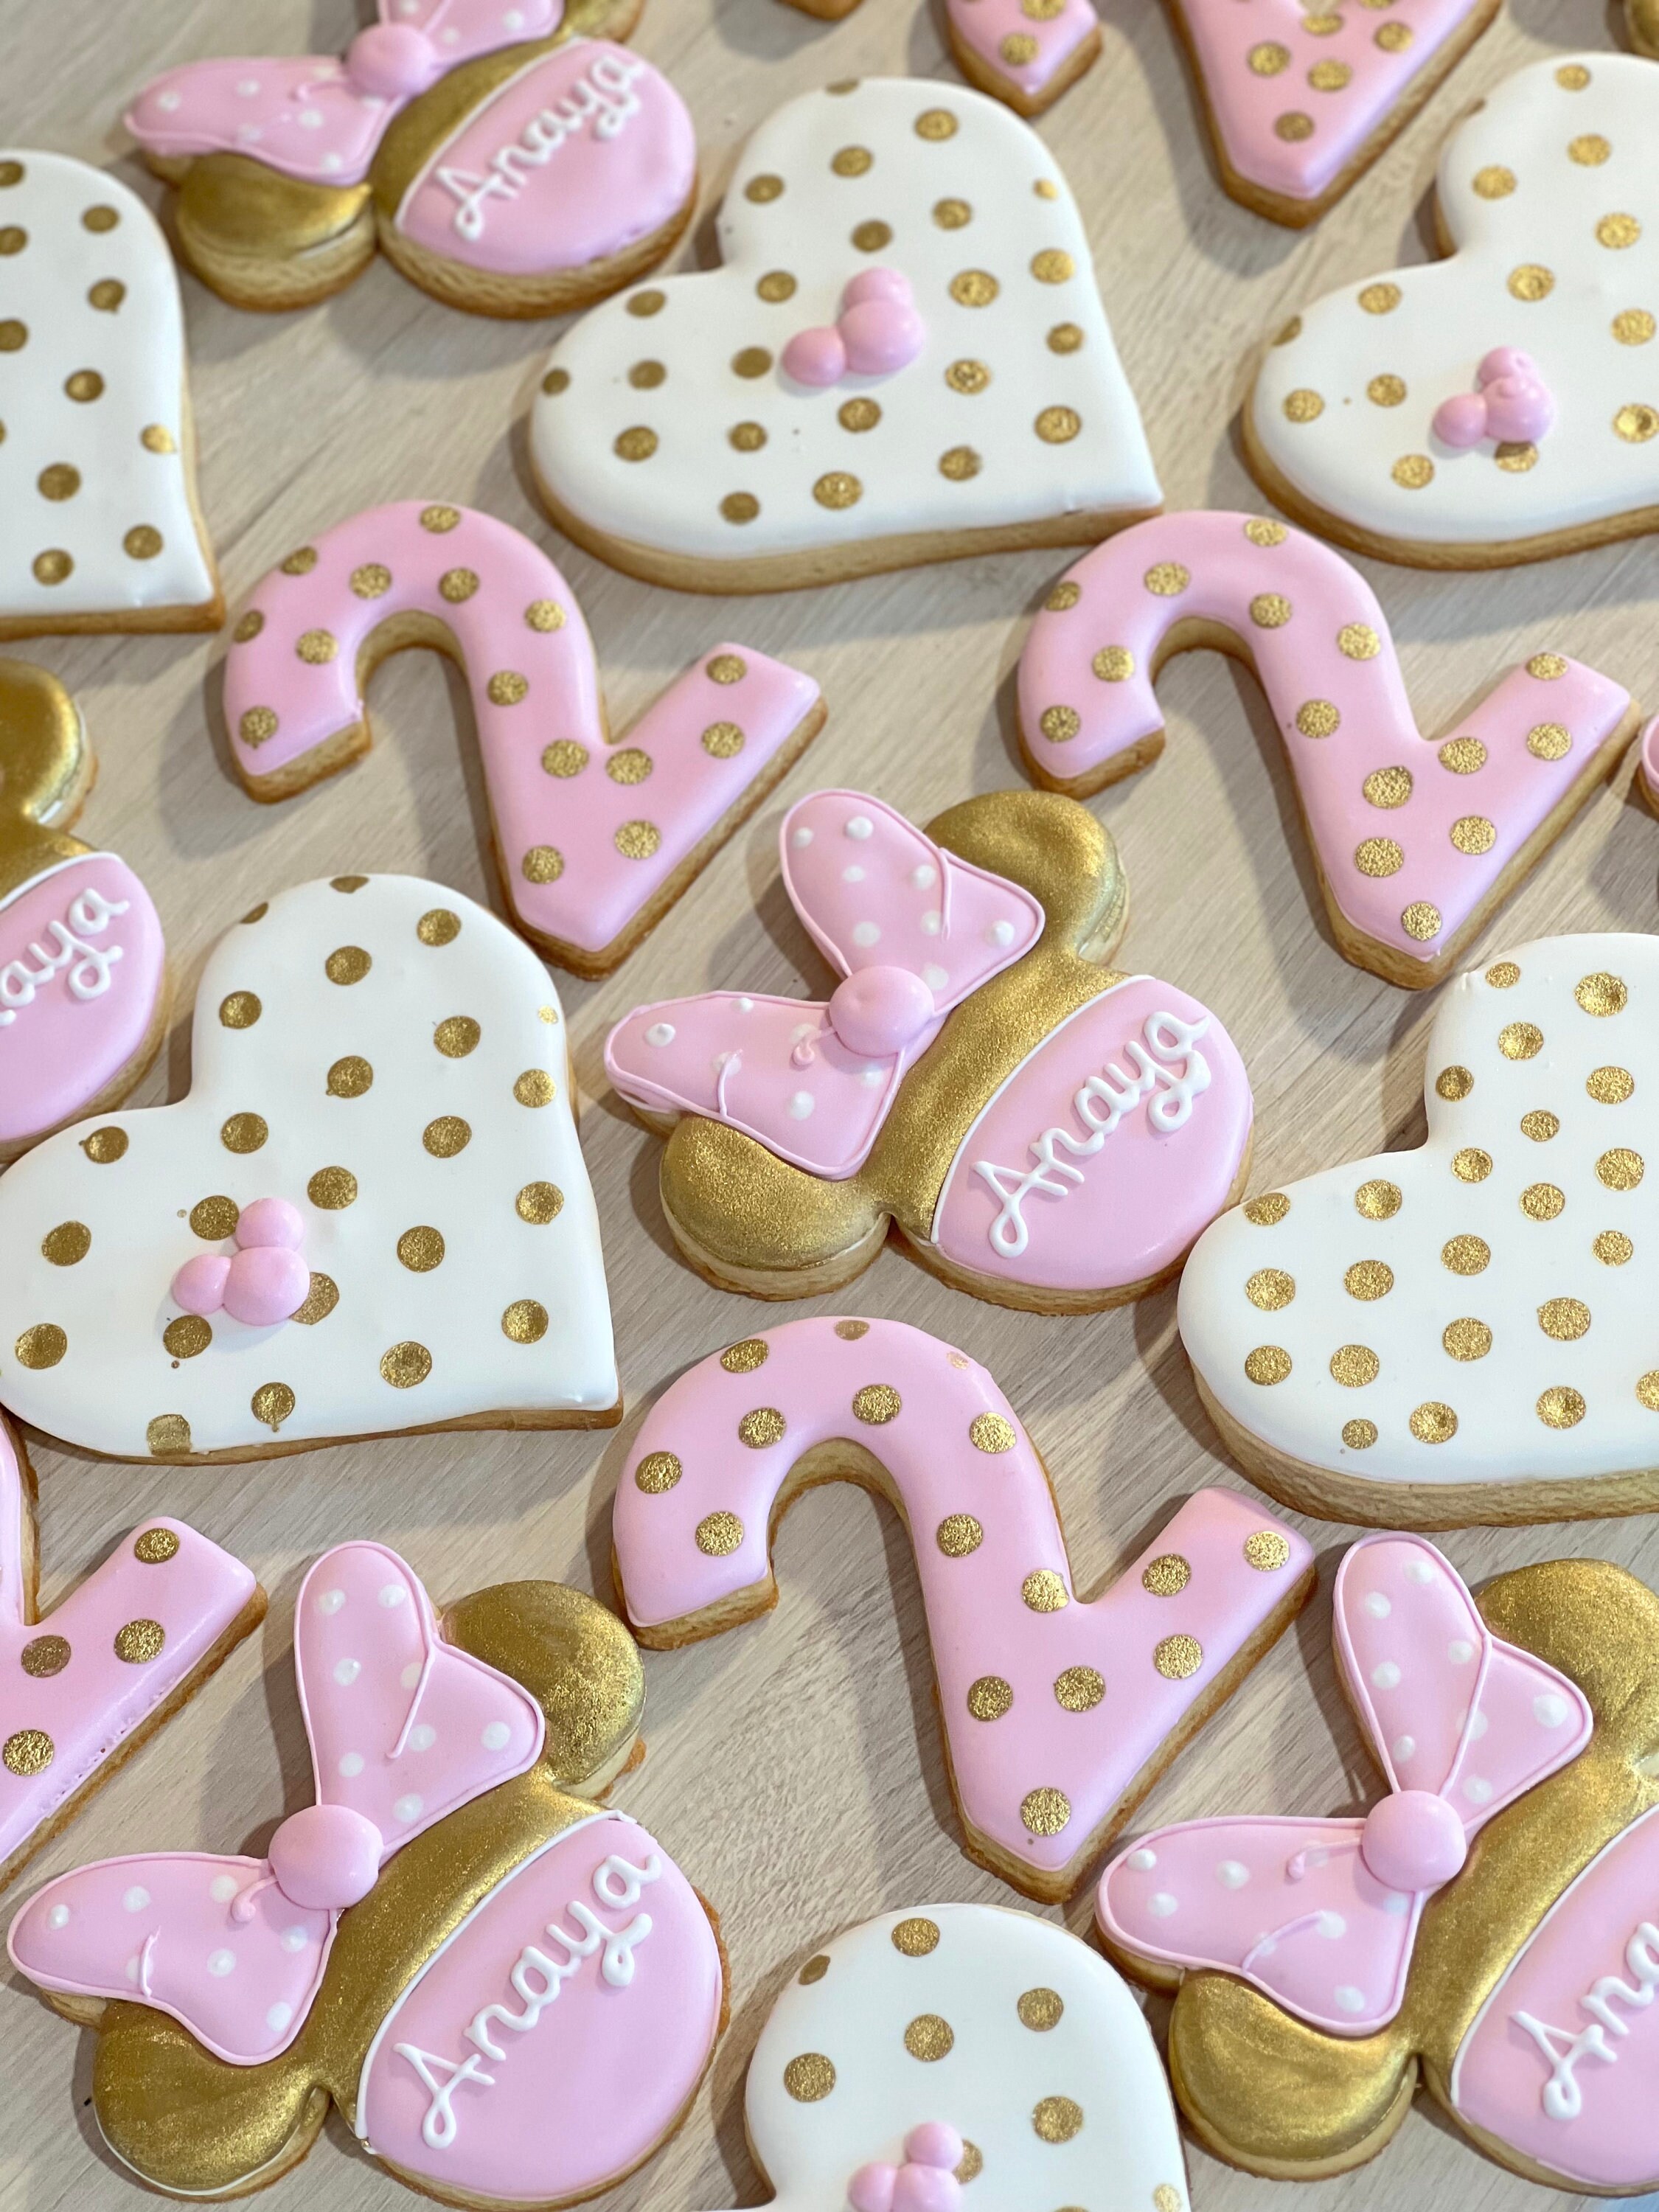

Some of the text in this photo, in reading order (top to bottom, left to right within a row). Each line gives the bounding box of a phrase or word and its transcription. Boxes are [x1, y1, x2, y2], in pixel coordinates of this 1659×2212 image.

[437, 55, 645, 242] Anaya
[0, 888, 131, 1026] aya
[973, 1011, 1211, 1258] Anaya
[392, 1854, 662, 2149] Anaya
